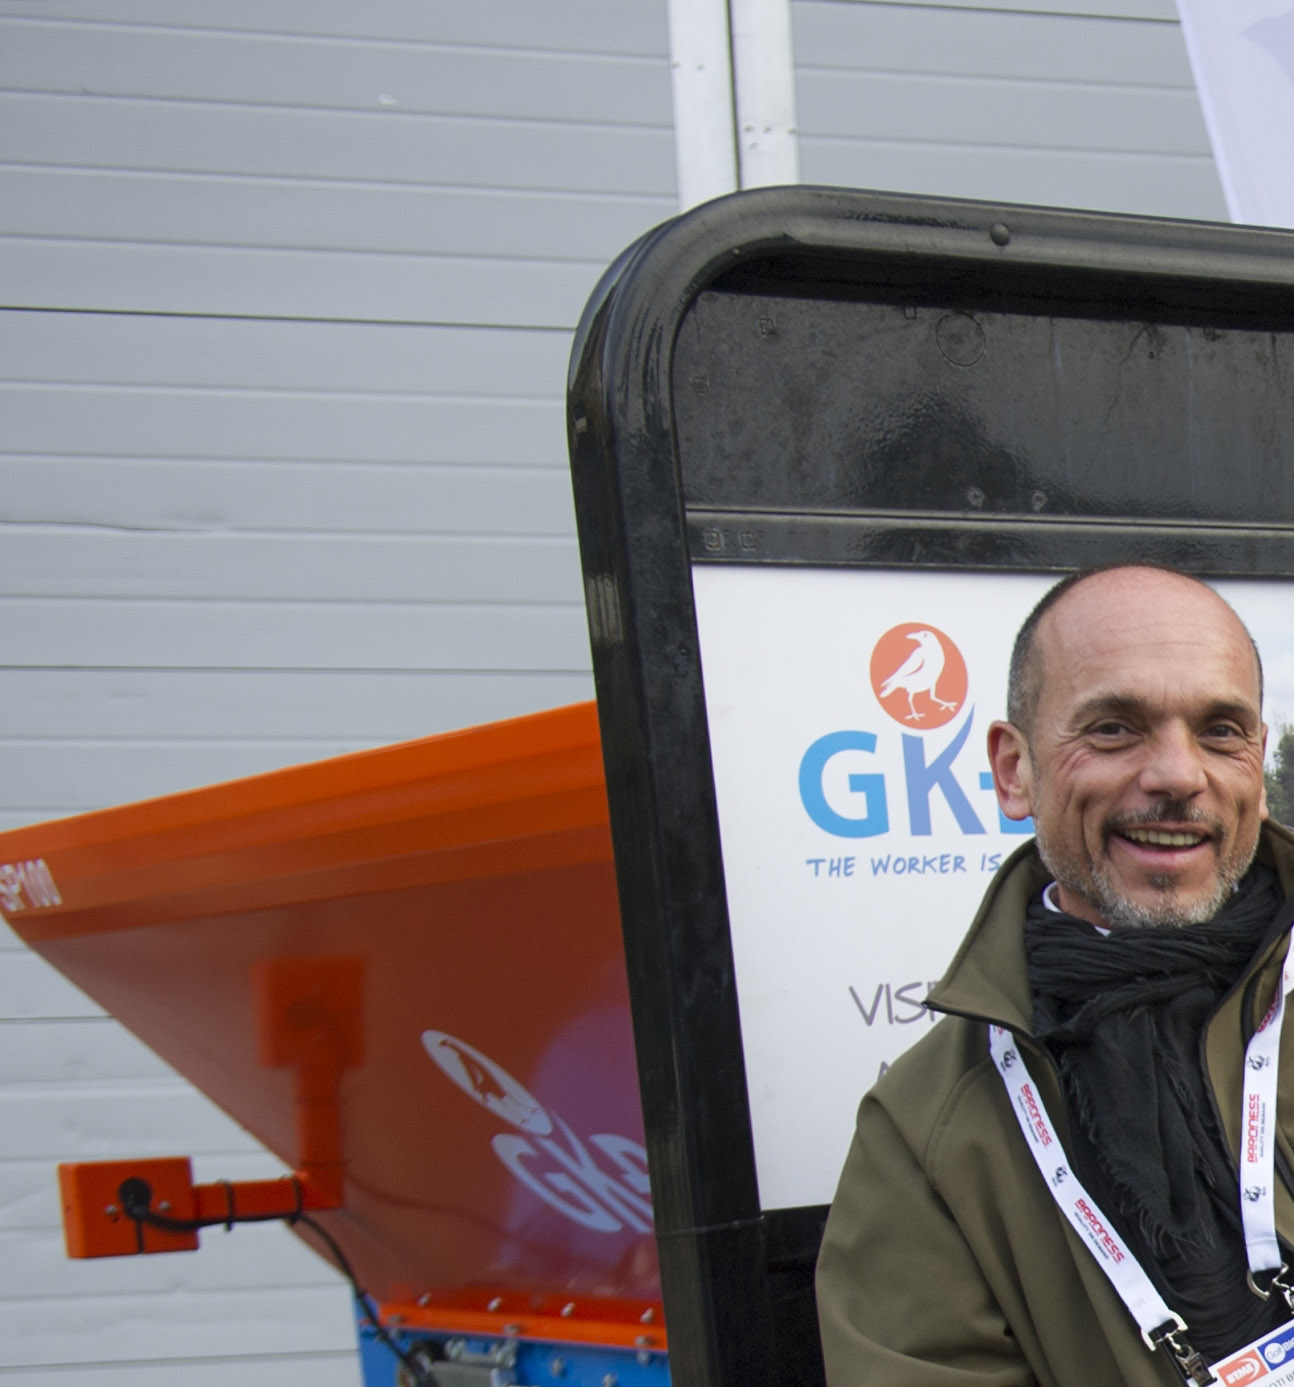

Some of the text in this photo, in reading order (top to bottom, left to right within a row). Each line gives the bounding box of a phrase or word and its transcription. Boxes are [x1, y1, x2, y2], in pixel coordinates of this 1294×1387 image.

[798, 701, 1034, 838] GK
[806, 853, 1002, 877] THE WORKER IS
[849, 980, 939, 1026] VISI
[1247, 1094, 1260, 1163] BARONESS
[1075, 1199, 1124, 1263] BARONESS
